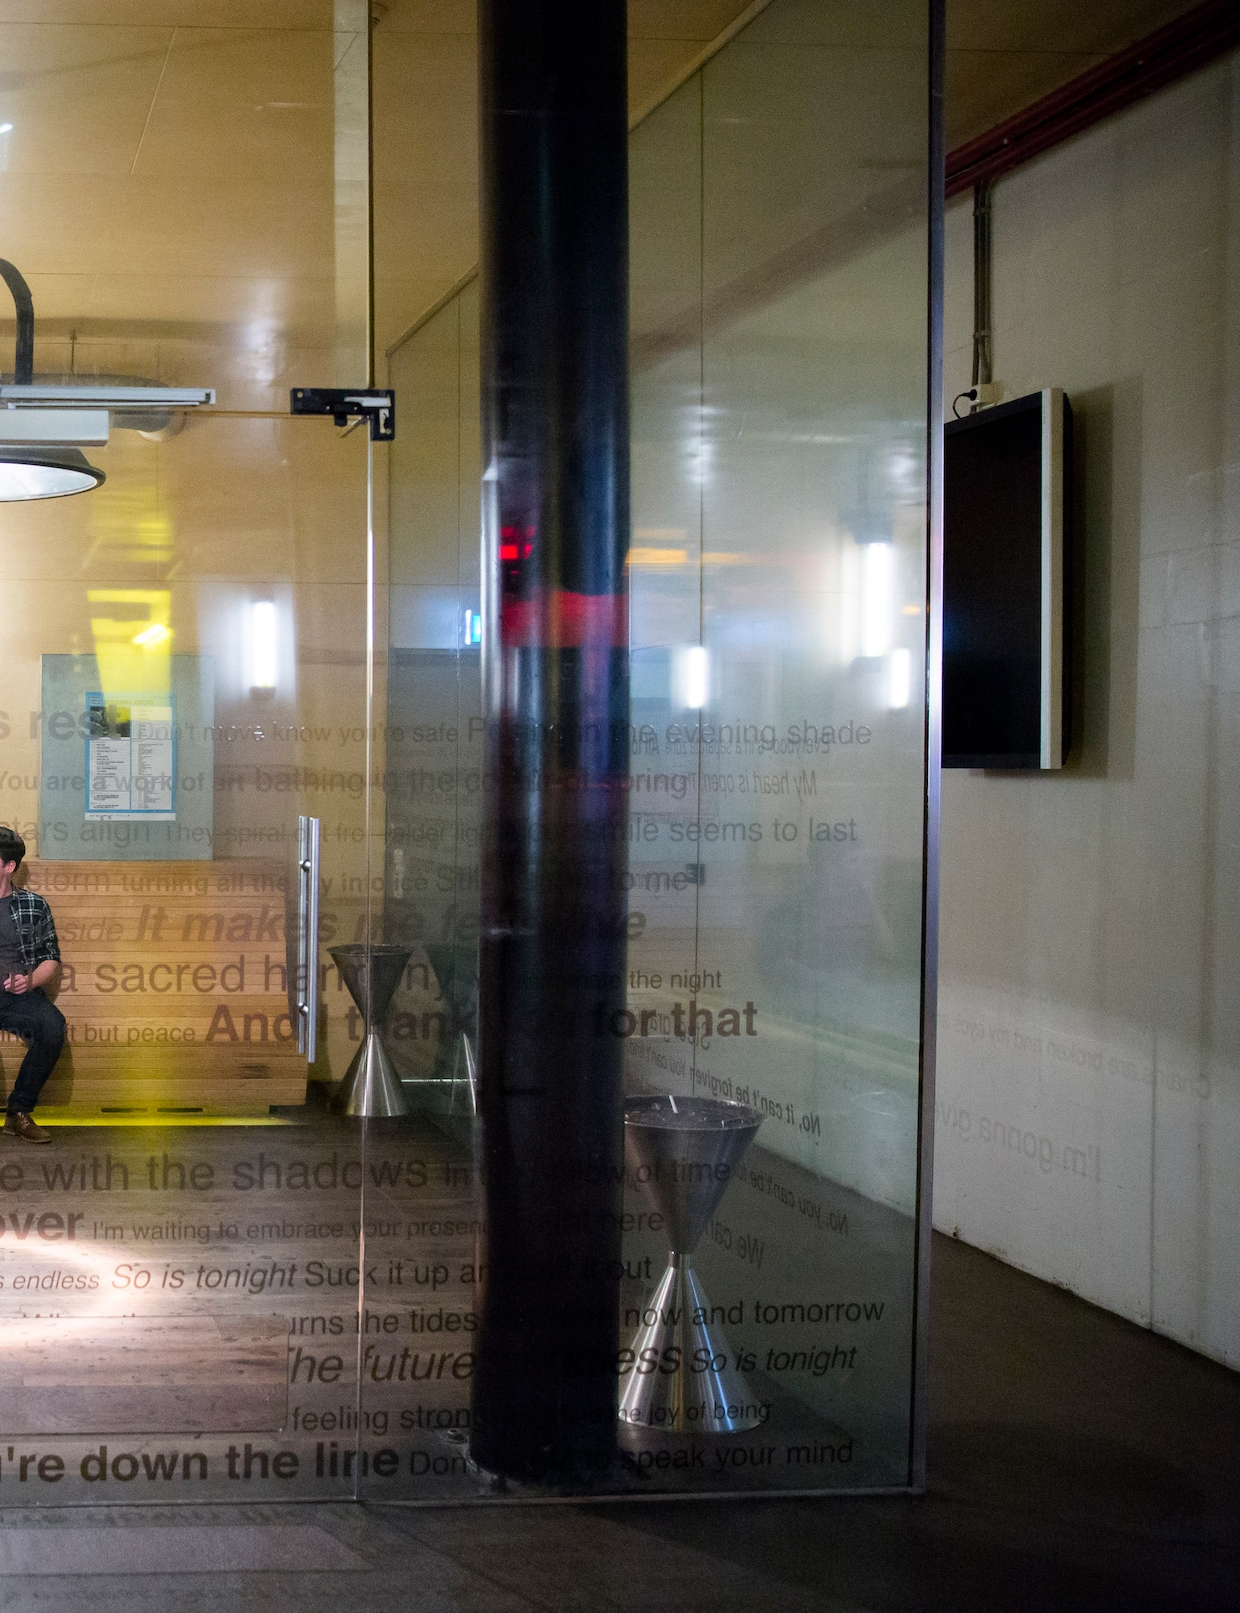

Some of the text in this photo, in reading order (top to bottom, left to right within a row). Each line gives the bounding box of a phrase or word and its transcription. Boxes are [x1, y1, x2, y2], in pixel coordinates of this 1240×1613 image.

[272, 722, 330, 742] know
[413, 722, 458, 742] safe
[666, 720, 776, 750] evening
[787, 720, 872, 744] shade
[47, 776, 85, 791] are
[93, 776, 106, 791] a
[116, 771, 172, 791] work
[183, 773, 205, 791] of
[255, 767, 364, 798] bathing
[410, 767, 455, 792] the
[80, 816, 150, 847] align
[165, 823, 214, 848] They
[670, 821, 763, 842] seems
[773, 819, 798, 842] to
[809, 817, 857, 842] last
[35, 870, 110, 891] storm
[121, 874, 209, 897] turning
[217, 870, 244, 892] all
[135, 903, 165, 942] It
[95, 954, 245, 993] sacred
[630, 971, 662, 989] the
[670, 969, 722, 993] night
[84, 1023, 119, 1042] but
[128, 1026, 195, 1048] peace
[207, 1003, 298, 1042] And
[671, 1000, 758, 1036] that
[42, 1155, 129, 1191] with
[148, 1154, 214, 1191] the
[232, 1152, 428, 1191] shadows
[93, 1222, 124, 1239] I'm
[132, 1221, 211, 1244] waiting
[215, 1222, 239, 1240] to
[247, 1220, 342, 1239] embrace
[12, 1271, 100, 1290] endless
[112, 1263, 151, 1289] So
[161, 1262, 185, 1289] is
[196, 1262, 297, 1294] tonight
[305, 1261, 377, 1287] Suck
[389, 1260, 403, 1285] it
[414, 1266, 449, 1291] up
[354, 1310, 408, 1335] the
[410, 1309, 479, 1333] tides
[693, 1301, 743, 1325] and
[754, 1301, 885, 1324] tomorrow
[364, 1345, 477, 1382] future
[691, 1349, 726, 1373] So
[735, 1348, 756, 1371] is
[766, 1344, 857, 1376] tonight
[292, 1405, 388, 1434] feeling
[649, 1403, 679, 1425] joy
[686, 1401, 706, 1420] of
[714, 1401, 770, 1423] being
[80, 1445, 208, 1482] down
[225, 1443, 300, 1479] the
[315, 1442, 400, 1478] line
[621, 1445, 705, 1470] speak
[716, 1448, 775, 1473] your
[787, 1437, 853, 1464] mind
